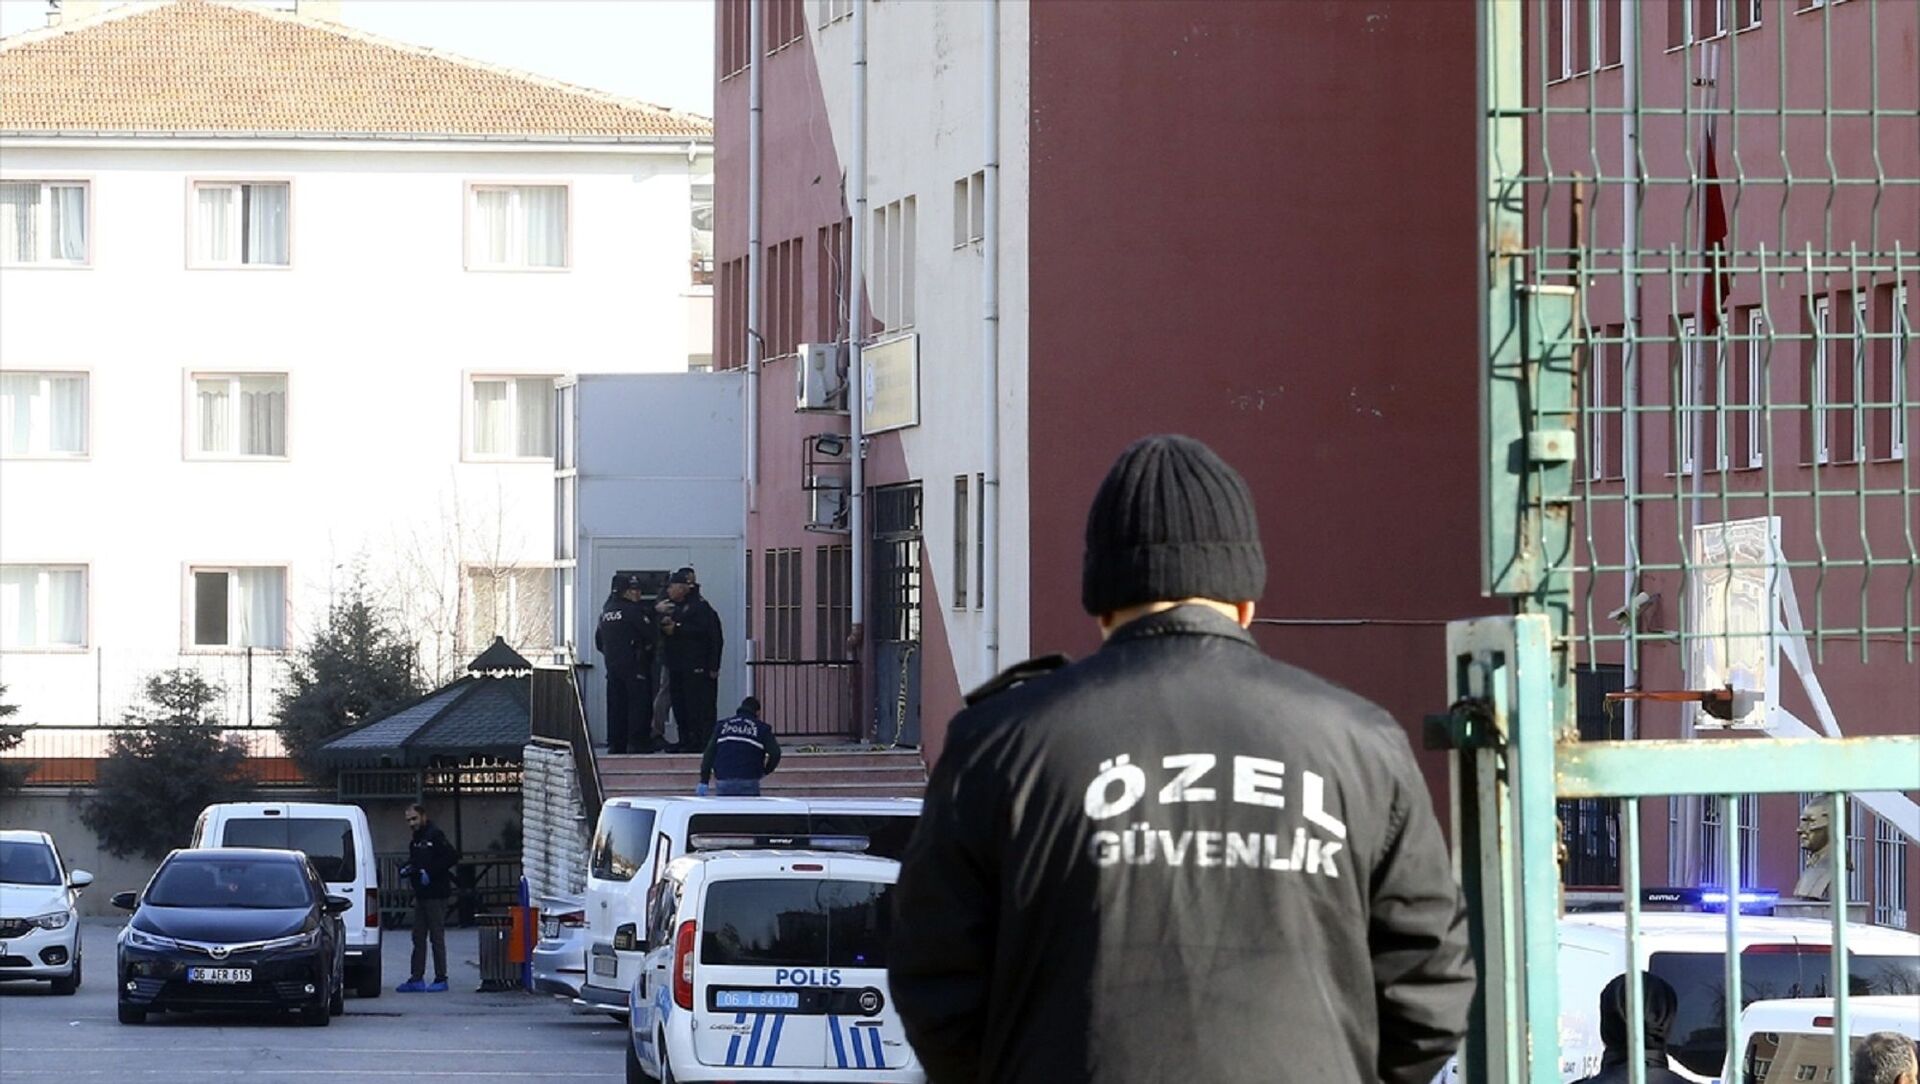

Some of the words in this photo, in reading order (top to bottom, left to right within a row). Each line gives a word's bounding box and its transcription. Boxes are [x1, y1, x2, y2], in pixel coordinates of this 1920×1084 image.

[1084, 753, 1347, 839] ÖZEL
[1090, 821, 1343, 878] GÜVENLİK
[193, 968, 205, 979] 06
[725, 993, 739, 1006] 06
[746, 993, 753, 1006] A
